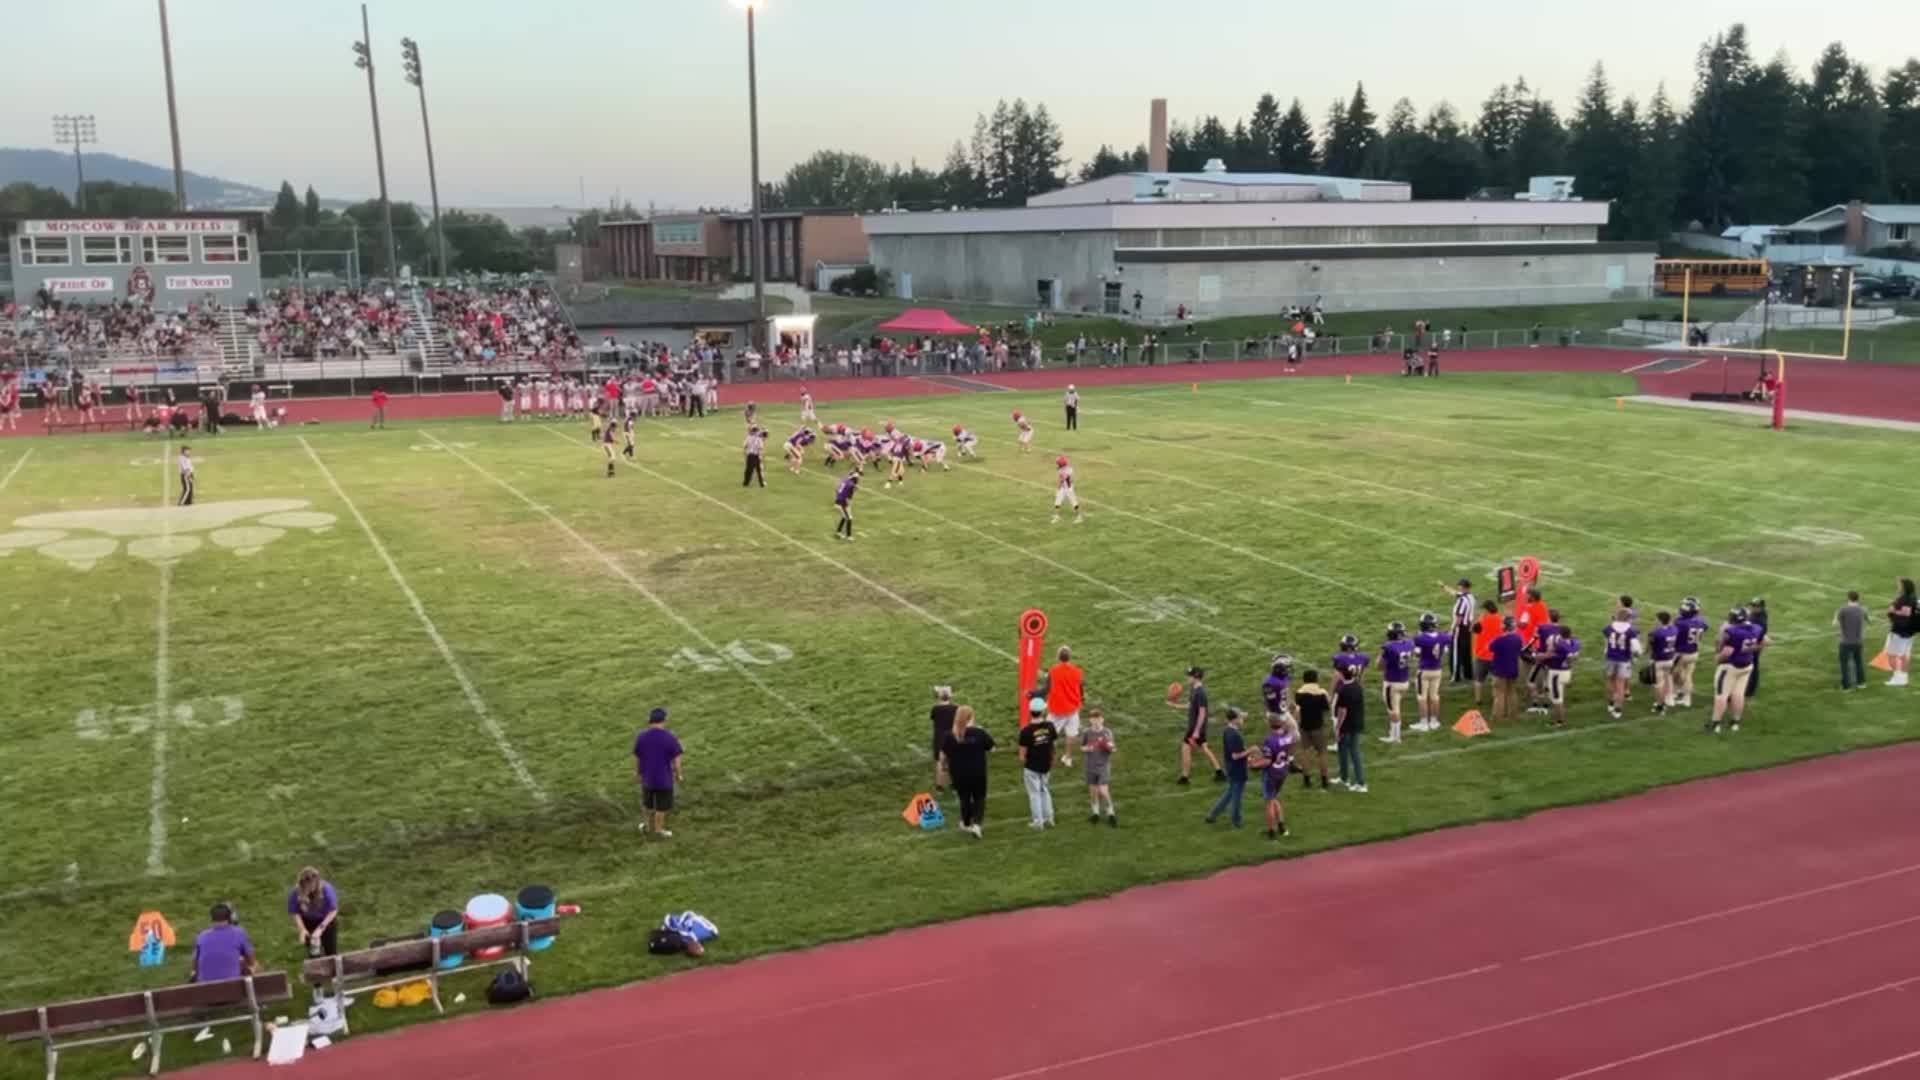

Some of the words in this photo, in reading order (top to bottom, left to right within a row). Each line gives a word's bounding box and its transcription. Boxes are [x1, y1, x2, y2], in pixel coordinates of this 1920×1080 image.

[47, 222, 115, 232] MOSCOW
[125, 222, 168, 232] BEAR
[174, 222, 222, 232] FIELD
[51, 280, 86, 289] PRIDE
[91, 279, 106, 289] OF
[191, 277, 230, 287] NORTH
[662, 640, 794, 672] 40
[76, 696, 243, 740] 50
